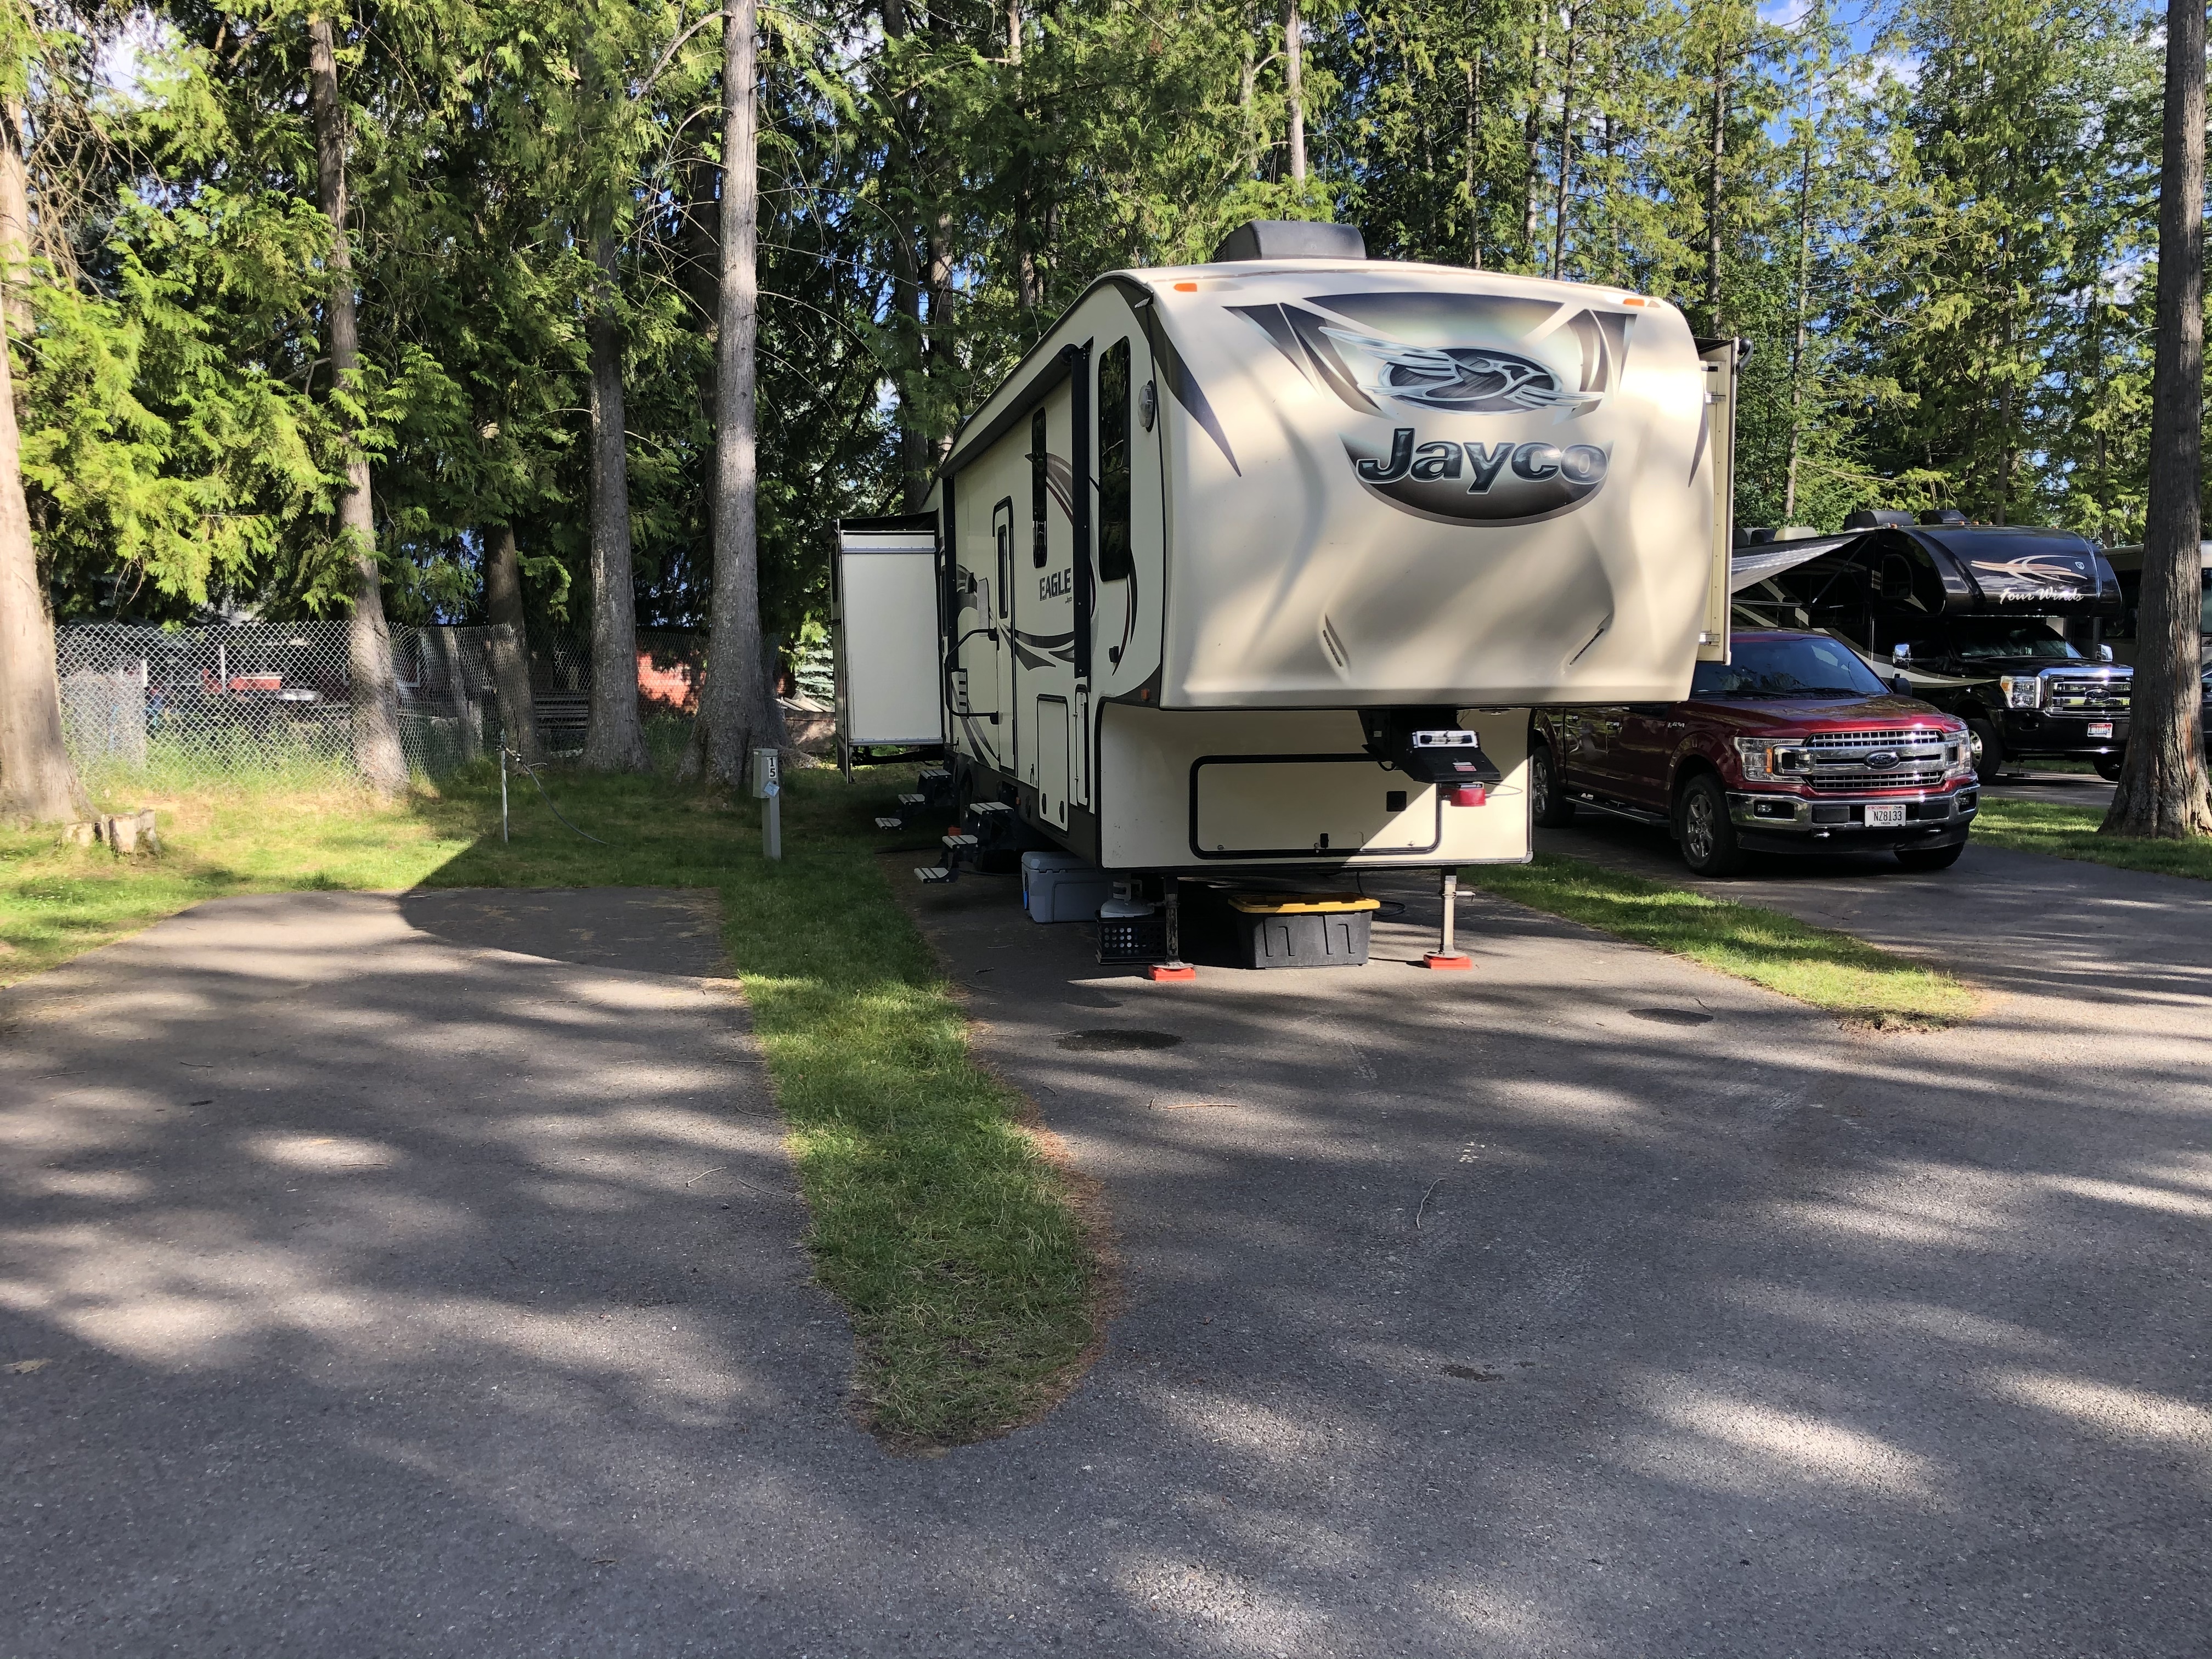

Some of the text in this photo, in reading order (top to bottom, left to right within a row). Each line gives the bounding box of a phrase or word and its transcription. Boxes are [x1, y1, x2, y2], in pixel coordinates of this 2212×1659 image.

[1357, 427, 1609, 494] Jayco
[1039, 567, 1072, 602] EAGLE
[2000, 587, 2035, 605] Four
[1873, 810, 1902, 821] NZ8133
